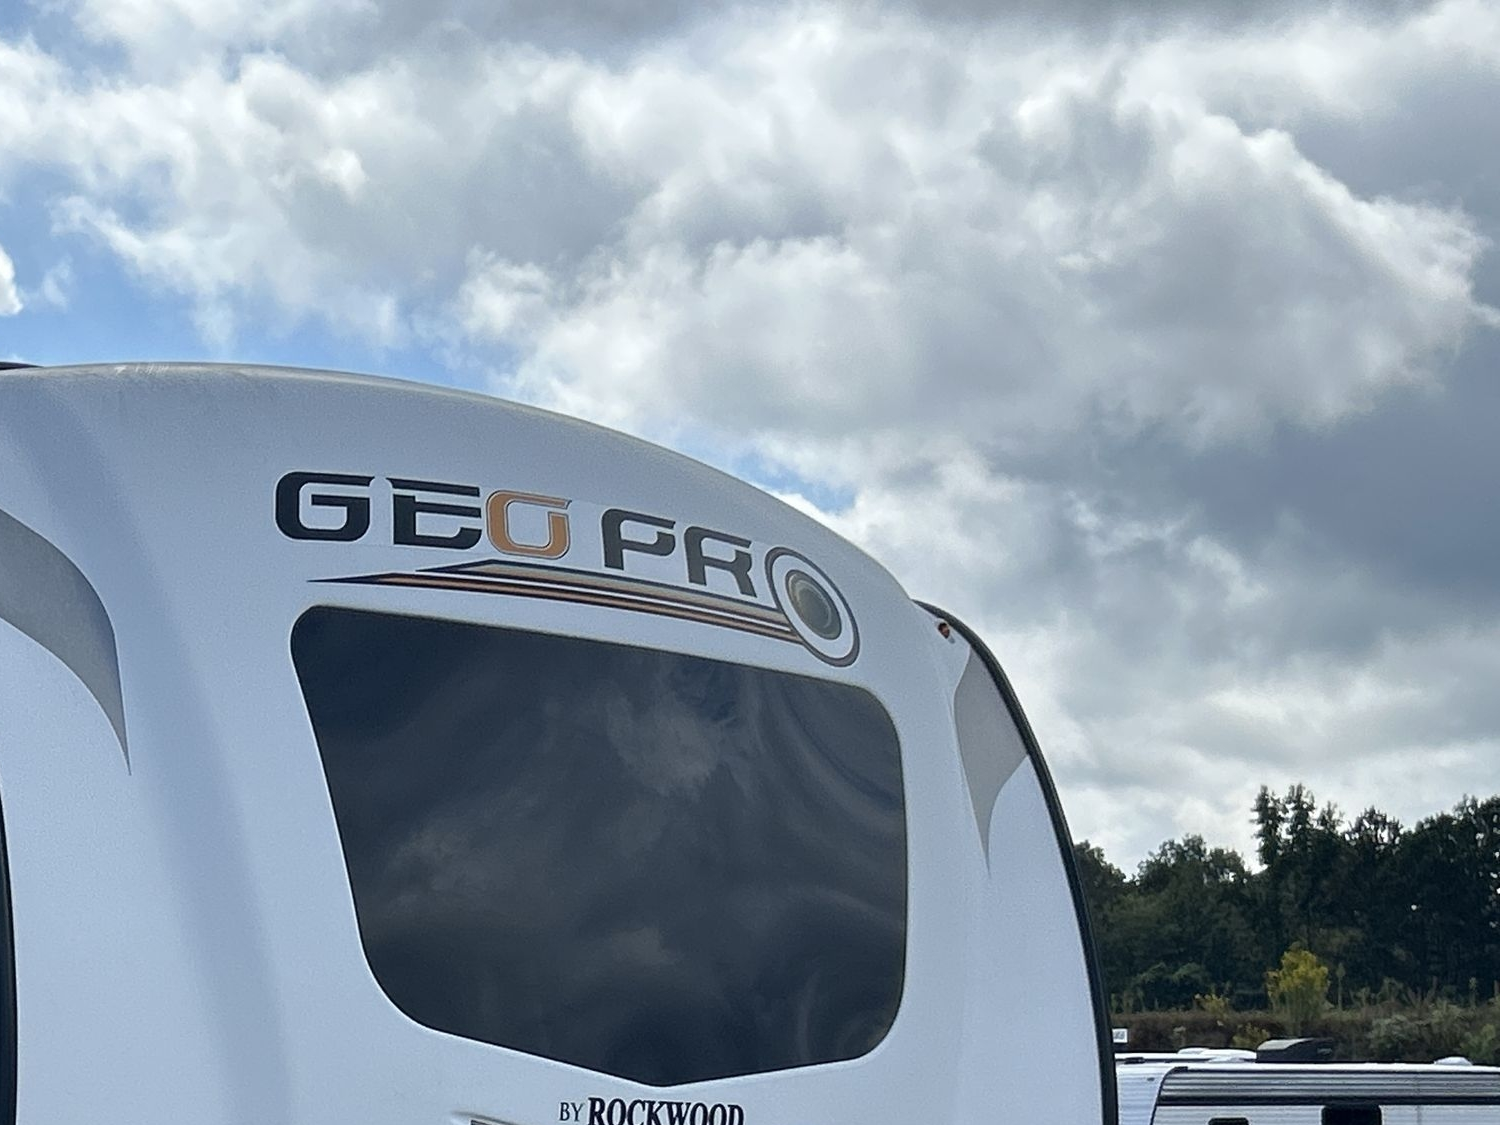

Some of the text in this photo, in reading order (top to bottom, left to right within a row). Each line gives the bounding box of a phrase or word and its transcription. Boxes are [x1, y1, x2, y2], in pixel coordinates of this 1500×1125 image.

[275, 471, 860, 668] GEO PRO
[559, 1101, 585, 1122] BY
